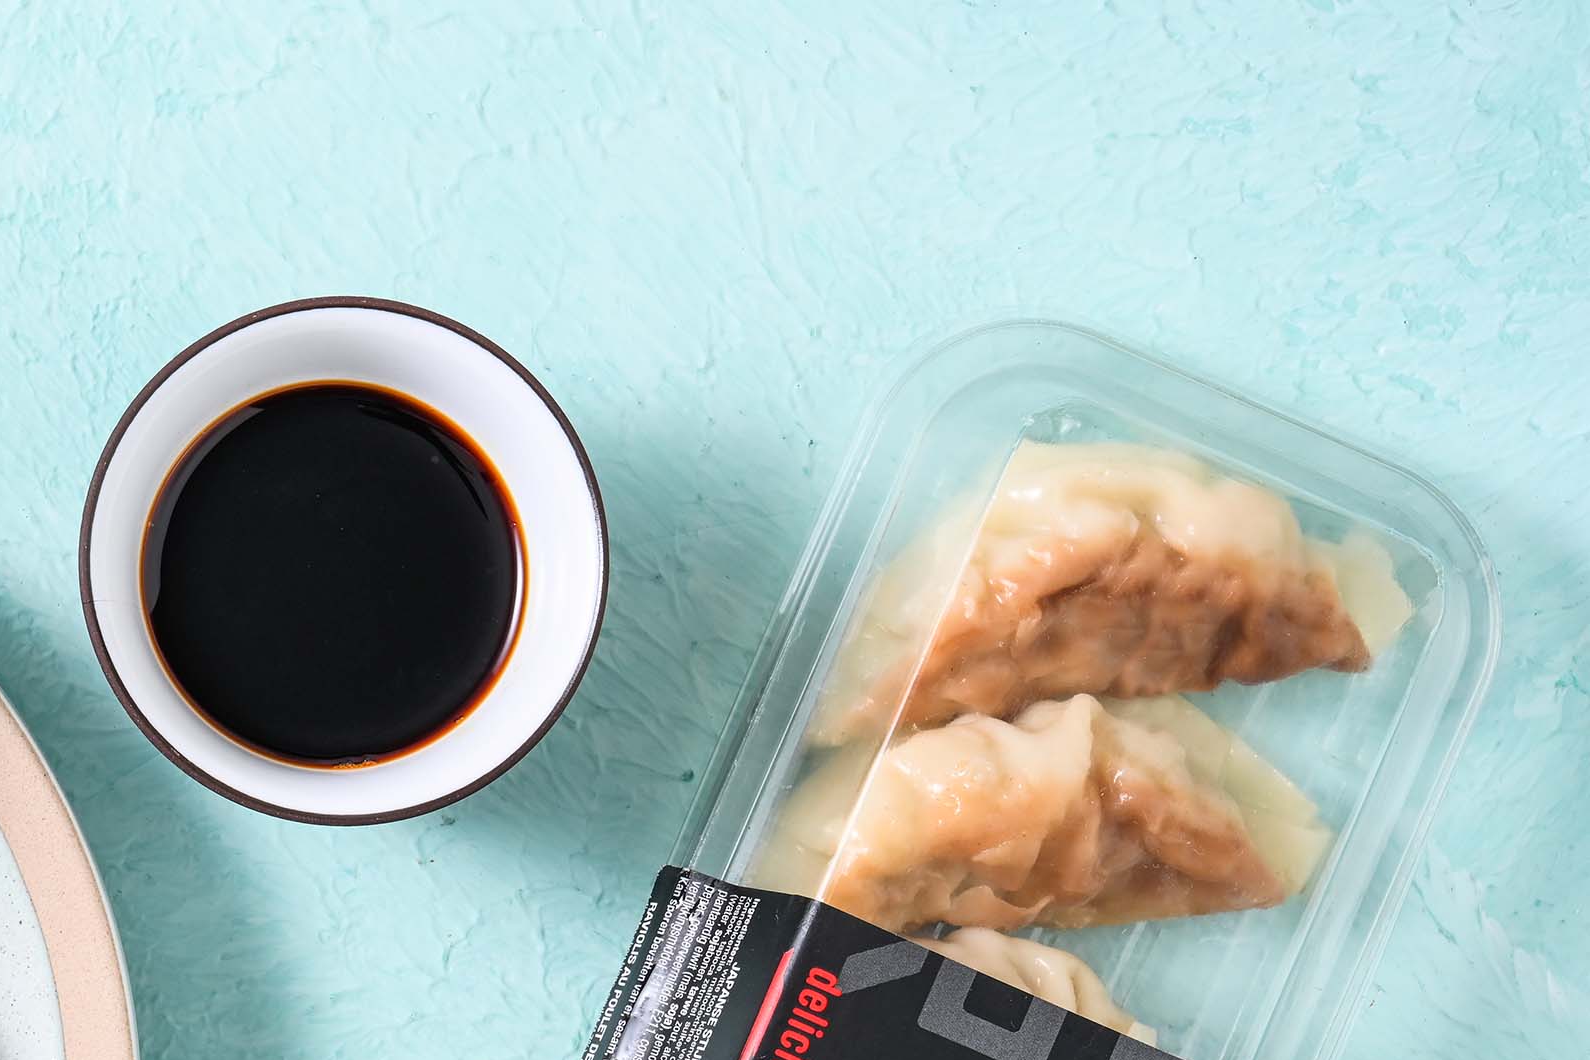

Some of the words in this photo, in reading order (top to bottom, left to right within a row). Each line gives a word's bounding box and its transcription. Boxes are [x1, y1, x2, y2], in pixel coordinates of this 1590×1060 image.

[672, 875, 689, 898] Kan
[655, 898, 678, 935] sporen
[695, 888, 729, 946] plantaardig
[717, 892, 739, 928] (water,
[625, 900, 659, 965] RAVIOLIS
[636, 935, 664, 983] bevatten
[655, 917, 703, 1007] conserveermiddel:
[686, 945, 705, 971] eiwit
[692, 927, 724, 985] sojabonen,
[706, 939, 726, 976] tapioca
[617, 966, 631, 987] AU
[627, 982, 642, 1003] van
[706, 960, 742, 1028] JAPANSE
[714, 967, 729, 993] witte
[593, 987, 622, 1041] POULET
[657, 1001, 681, 1034] soja),
[677, 984, 699, 1019] tarwe,
[603, 1018, 626, 1057] sesam,
[666, 1020, 683, 1046] zout,
